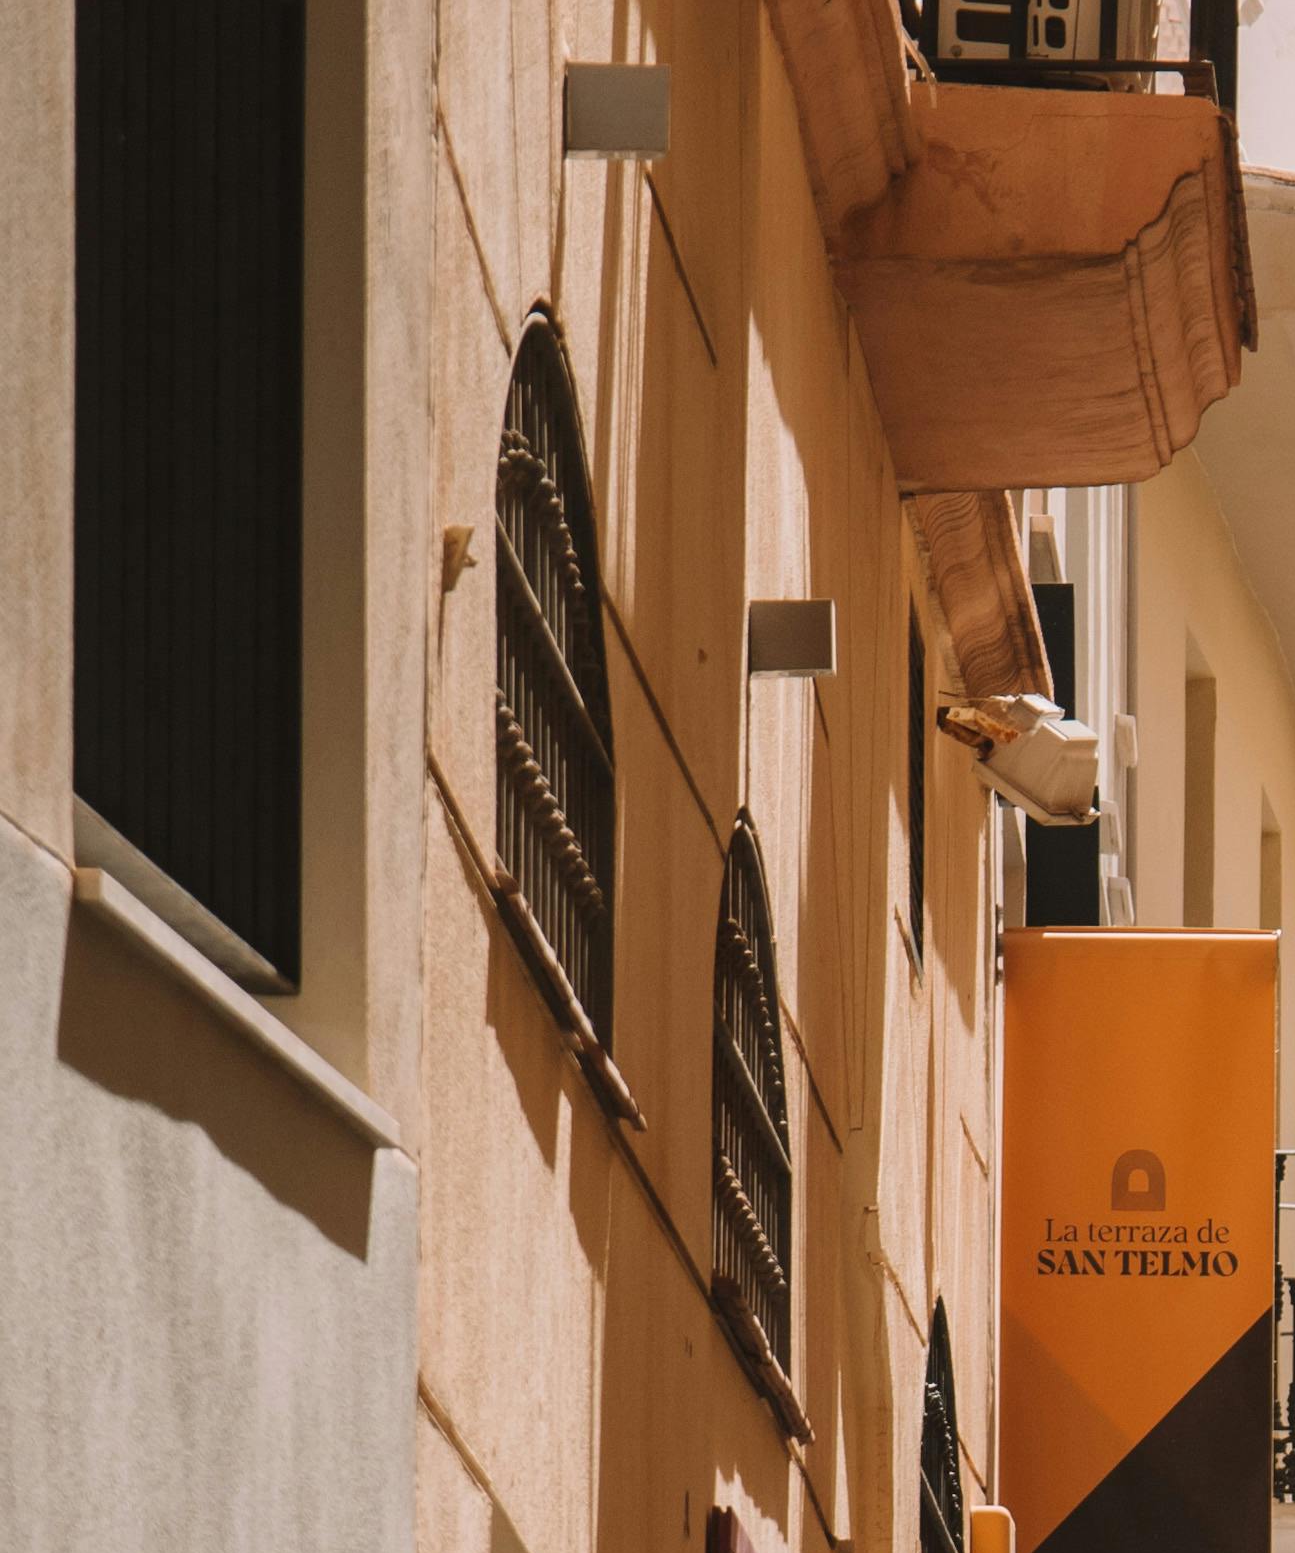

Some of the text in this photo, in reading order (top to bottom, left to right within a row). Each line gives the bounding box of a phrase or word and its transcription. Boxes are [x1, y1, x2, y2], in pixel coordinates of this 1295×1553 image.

[1044, 1218, 1230, 1245] La terraza de
[1037, 1249, 1239, 1278] SAN TELMO
